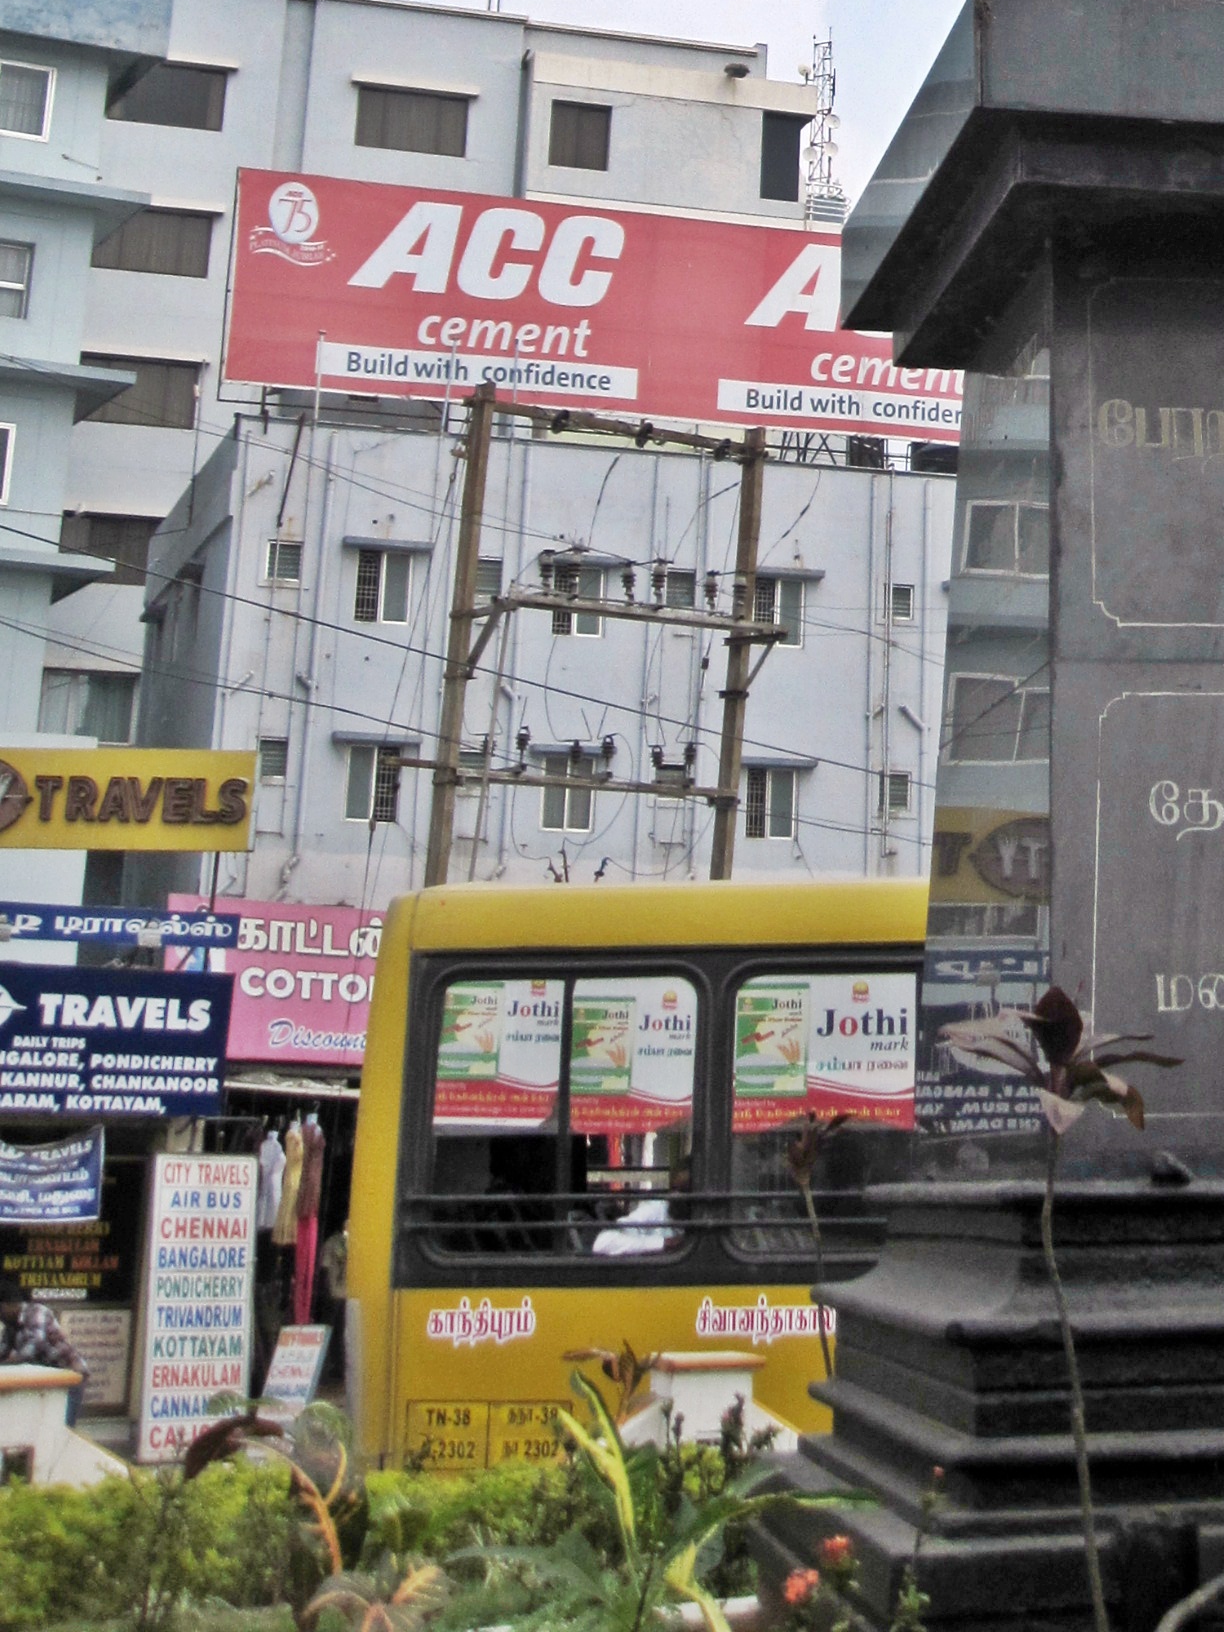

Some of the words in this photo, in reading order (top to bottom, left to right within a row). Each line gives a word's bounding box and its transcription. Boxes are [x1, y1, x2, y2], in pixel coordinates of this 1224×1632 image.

[279, 198, 312, 234] 75
[347, 200, 625, 307] ACC
[417, 315, 591, 357] cement
[347, 351, 408, 377] Build
[413, 357, 469, 382] with
[481, 364, 612, 391] confidence
[746, 388, 803, 411] Build
[810, 393, 861, 416] with
[35, 774, 250, 825] TRAVELS
[240, 966, 375, 1003] COTTO
[39, 993, 212, 1031] TRAVELS
[507, 1000, 560, 1017] Jothi
[638, 1014, 692, 1032] Jothi
[816, 1008, 908, 1037] Jothi
[13, 1035, 49, 1048] DAILY
[50, 1036, 87, 1049] TRIPS
[870, 1037, 909, 1052] mark
[90, 1053, 218, 1072] PONDICHERRY
[1, 1071, 86, 1091] KANNUR,
[91, 1074, 219, 1092] CHANKANOOR
[66, 1095, 167, 1114] KOTTAYAM,
[164, 1161, 192, 1184] CITY
[198, 1162, 250, 1186] TRAVELS
[171, 1190, 201, 1208] AIR
[207, 1191, 242, 1208] BUS
[160, 1216, 248, 1239] CHENNAI
[157, 1246, 246, 1268] BANGALORE
[156, 1275, 244, 1298] PONDICHERRY
[157, 1305, 243, 1328] TRIVANDRUM
[428, 1296, 536, 1347] காந்திபுரம்
[153, 1335, 242, 1358] KOTTAYAM
[152, 1364, 241, 1388] ERNAKULAM
[426, 1407, 471, 1426] TN-38
